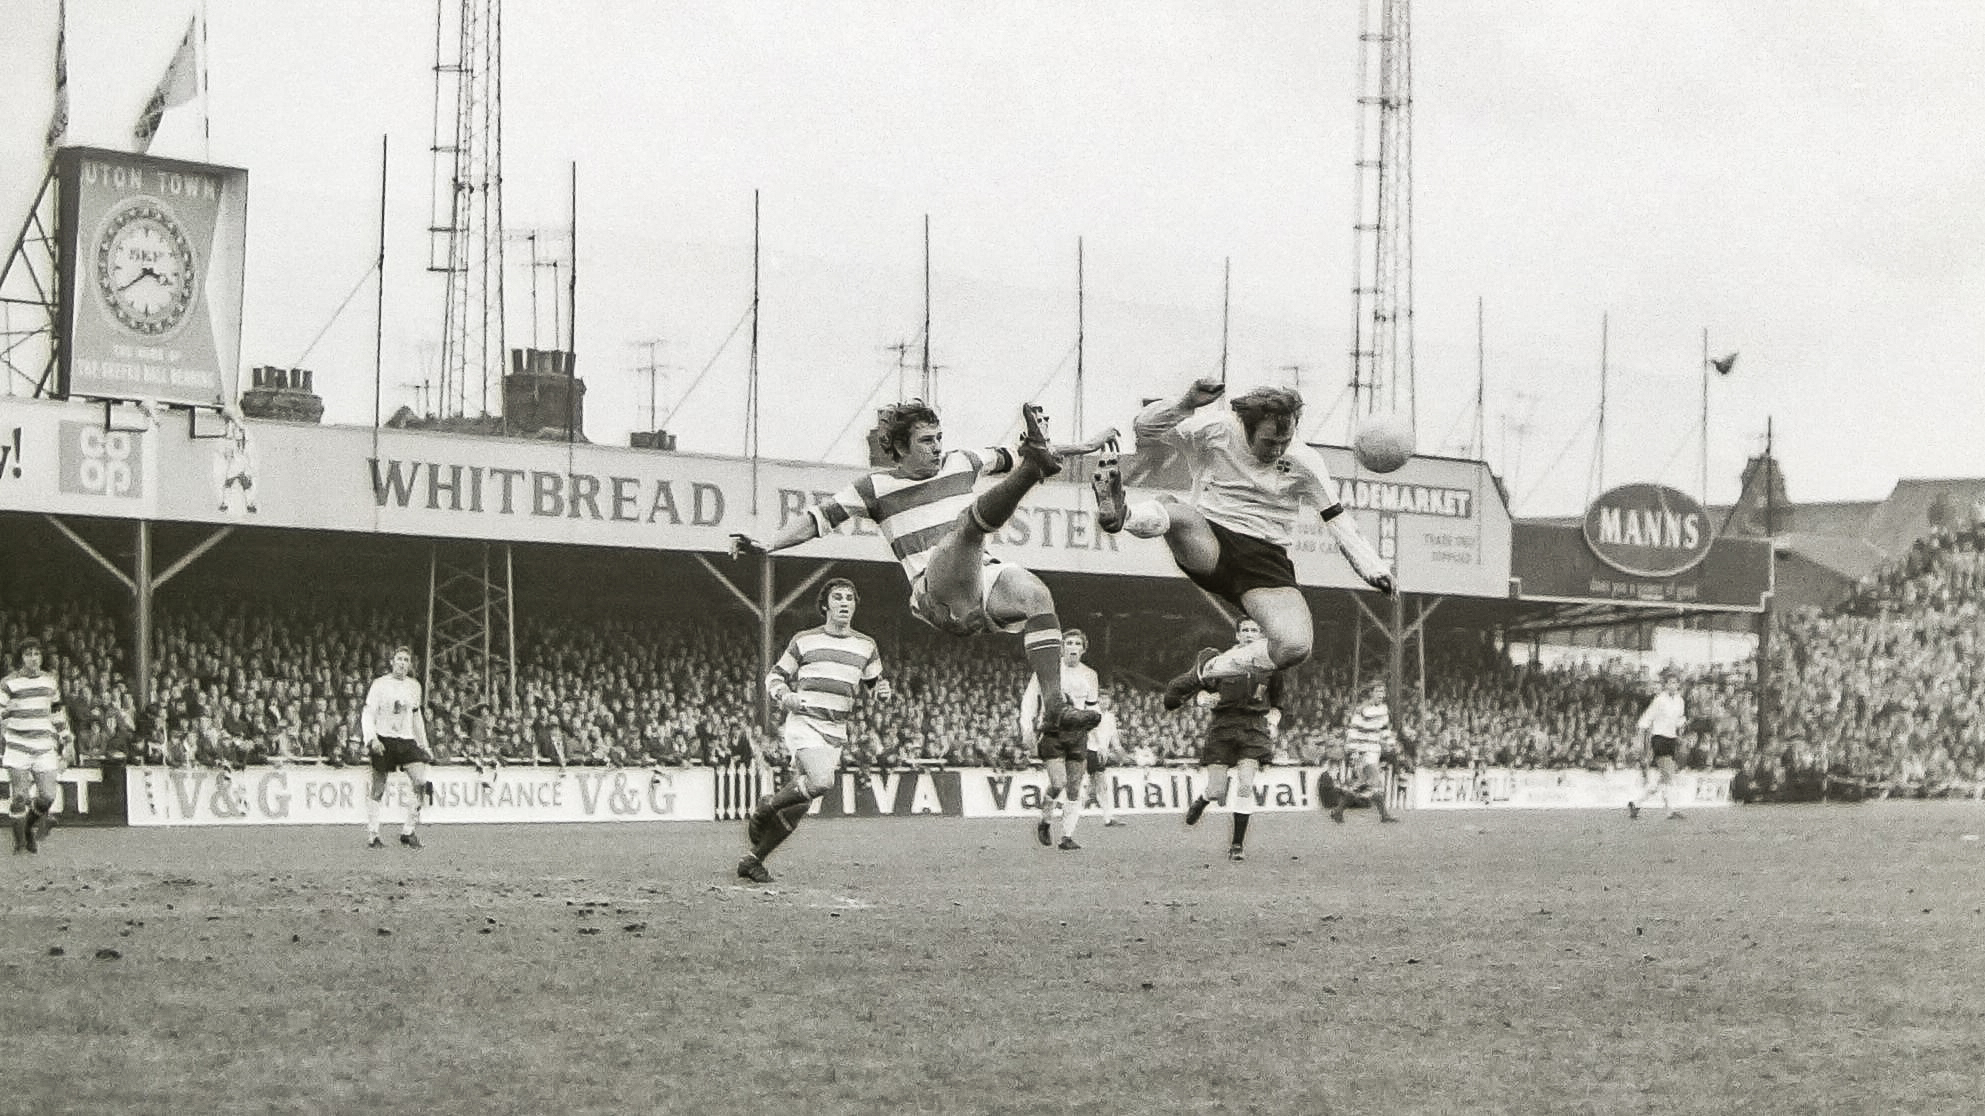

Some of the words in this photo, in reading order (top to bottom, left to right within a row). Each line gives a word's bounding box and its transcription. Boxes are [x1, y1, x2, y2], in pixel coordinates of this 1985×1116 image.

[84, 163, 143, 189] UTON
[367, 457, 725, 527] WHITBREAD
[1600, 506, 1700, 549] MANNS
[170, 770, 291, 819] V&G
[305, 781, 355, 809] FOR
[428, 779, 563, 808] NSURANCE
[575, 771, 677, 815] V&G
[807, 772, 944, 816] IVA
[986, 772, 1192, 811] Vahall
